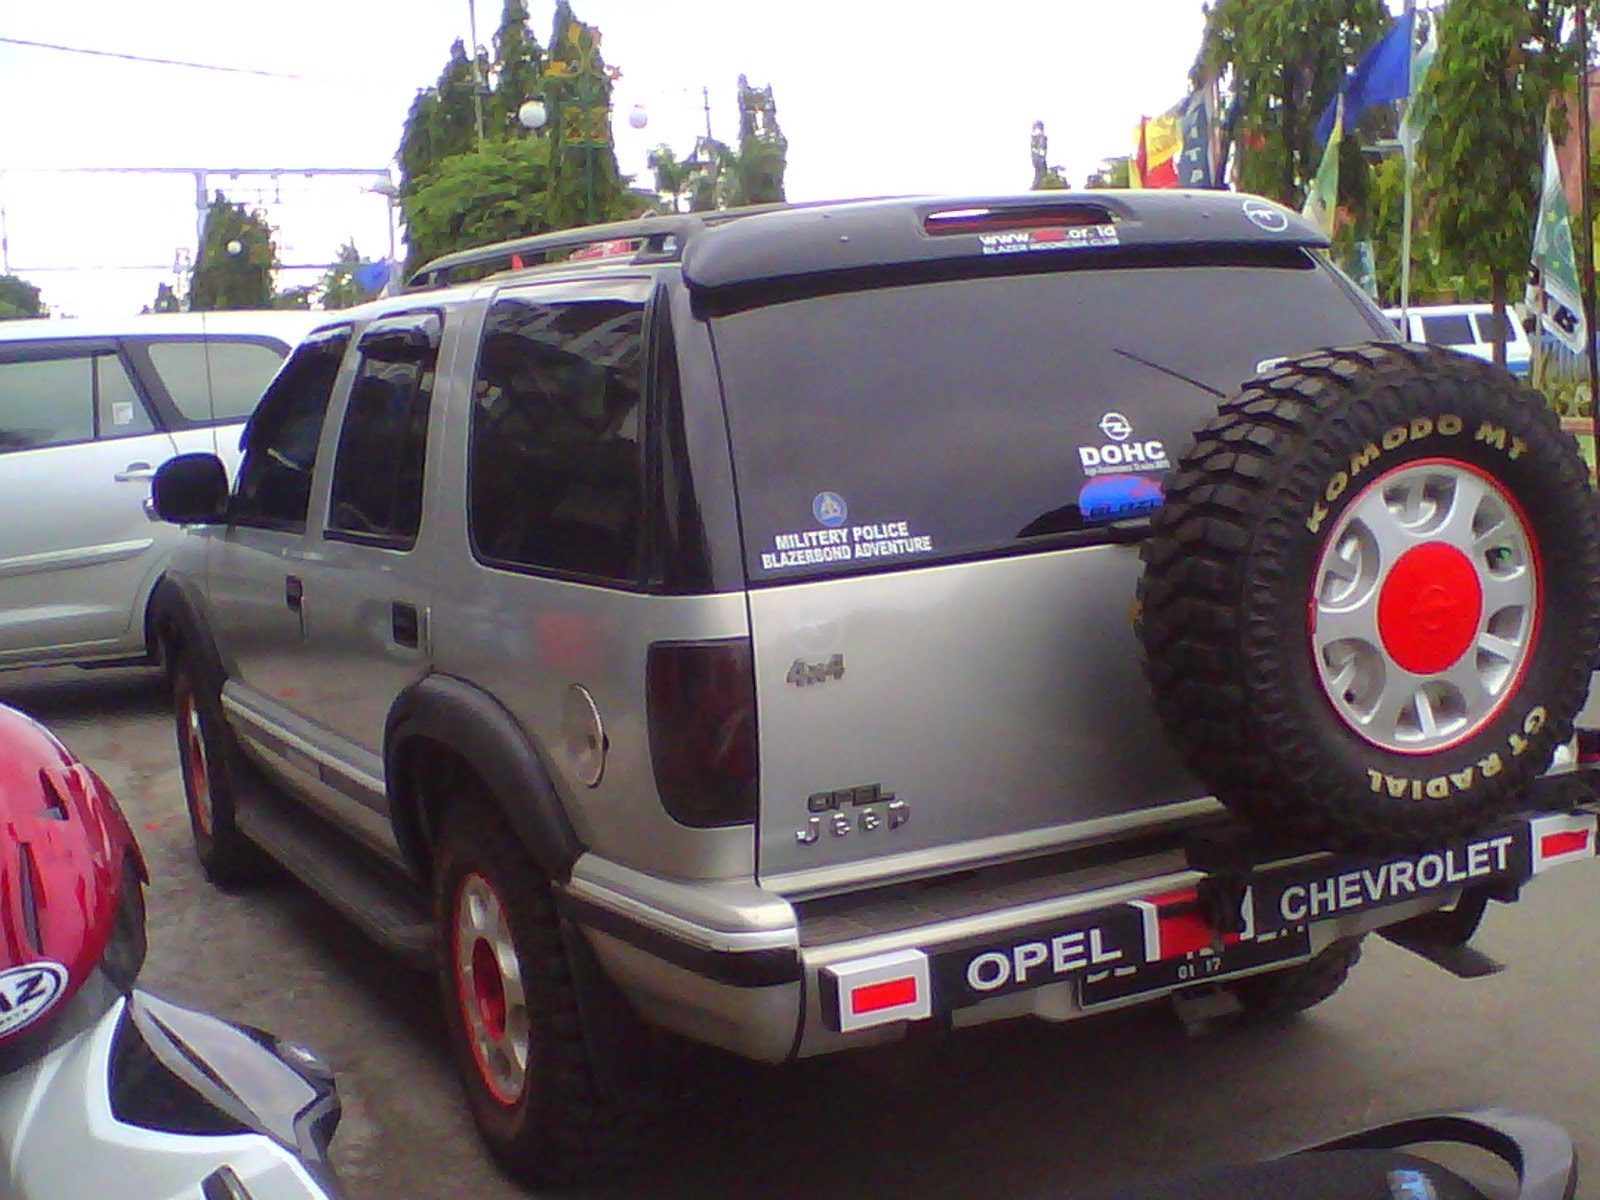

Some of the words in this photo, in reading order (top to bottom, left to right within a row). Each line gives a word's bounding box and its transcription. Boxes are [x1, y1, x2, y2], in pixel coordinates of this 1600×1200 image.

[1078, 441, 1166, 466] DOHC
[1305, 413, 1463, 534] KOMODO
[1475, 420, 1528, 461] MT
[761, 544, 851, 569] BLAZERBOND
[855, 535, 932, 558] ADVENTURE
[774, 528, 849, 550] MILITERY
[852, 521, 909, 541] POLICE
[1507, 705, 1549, 757] GT
[1367, 751, 1504, 801] RADIAL
[807, 782, 896, 813] OPEL
[966, 924, 1123, 992] OPEL
[1279, 835, 1513, 921] CHEVROLET
[1177, 963, 1196, 980] 01
